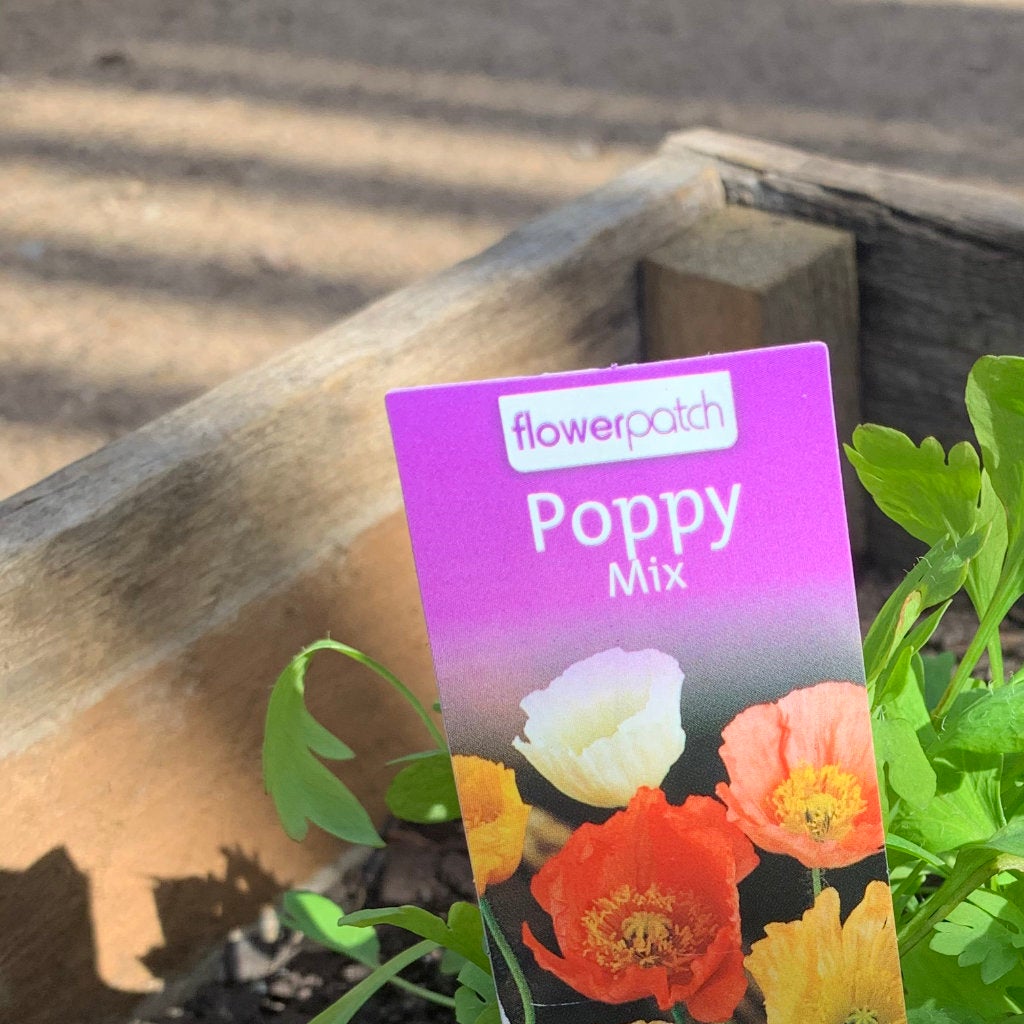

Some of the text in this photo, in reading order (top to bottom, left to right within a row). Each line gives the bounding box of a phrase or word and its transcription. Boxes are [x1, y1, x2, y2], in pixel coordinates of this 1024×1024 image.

[511, 390, 725, 451] flowerpatch
[526, 483, 742, 561] Poppy
[608, 556, 688, 598] Mix
